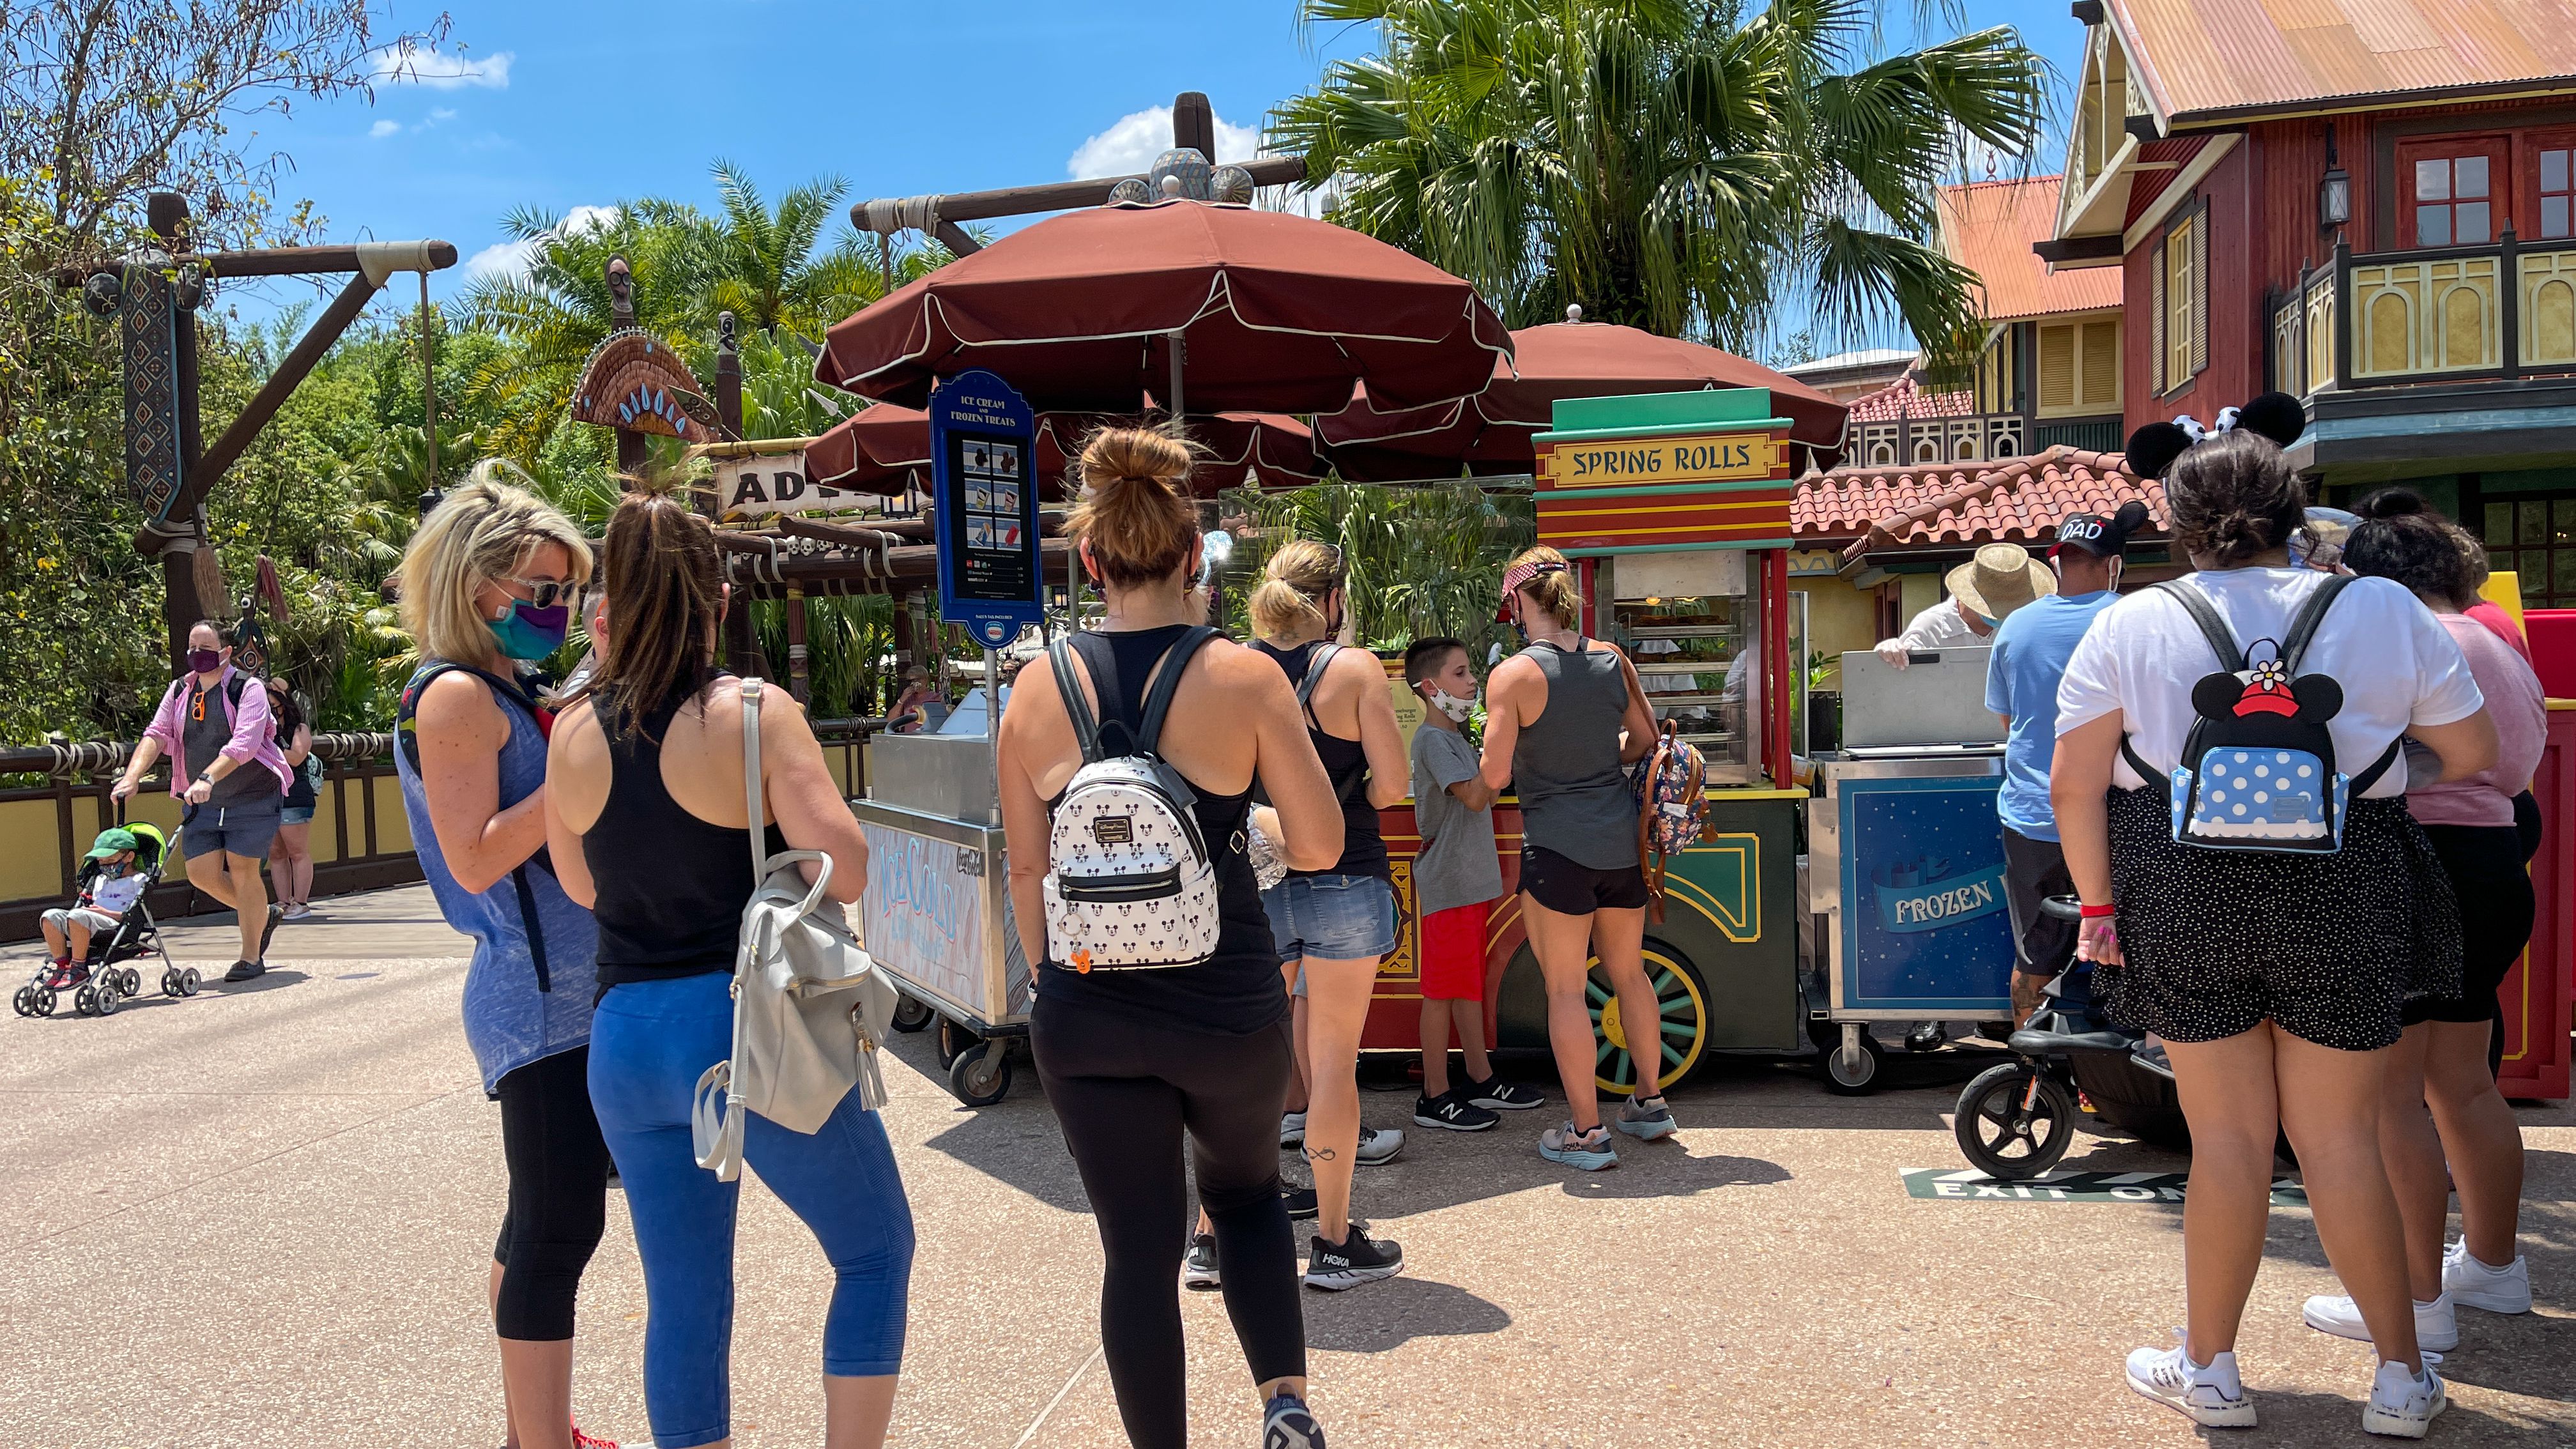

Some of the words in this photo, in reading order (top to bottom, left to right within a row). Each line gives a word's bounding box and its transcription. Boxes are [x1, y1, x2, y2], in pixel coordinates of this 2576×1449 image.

[961, 395, 974, 405] ICE
[976, 397, 1004, 409] CREAM
[951, 411, 983, 423] FROZEN
[985, 415, 1016, 427] TREATS
[1573, 449, 1661, 476] SPRING
[1675, 444, 1750, 472] ROLLS
[728, 471, 839, 509] AD
[2060, 519, 2103, 542] DAD
[1895, 880, 1993, 924] FROZEN
[1931, 1182, 2074, 1199] EXIT
[1322, 1254, 1349, 1268] HOKA
